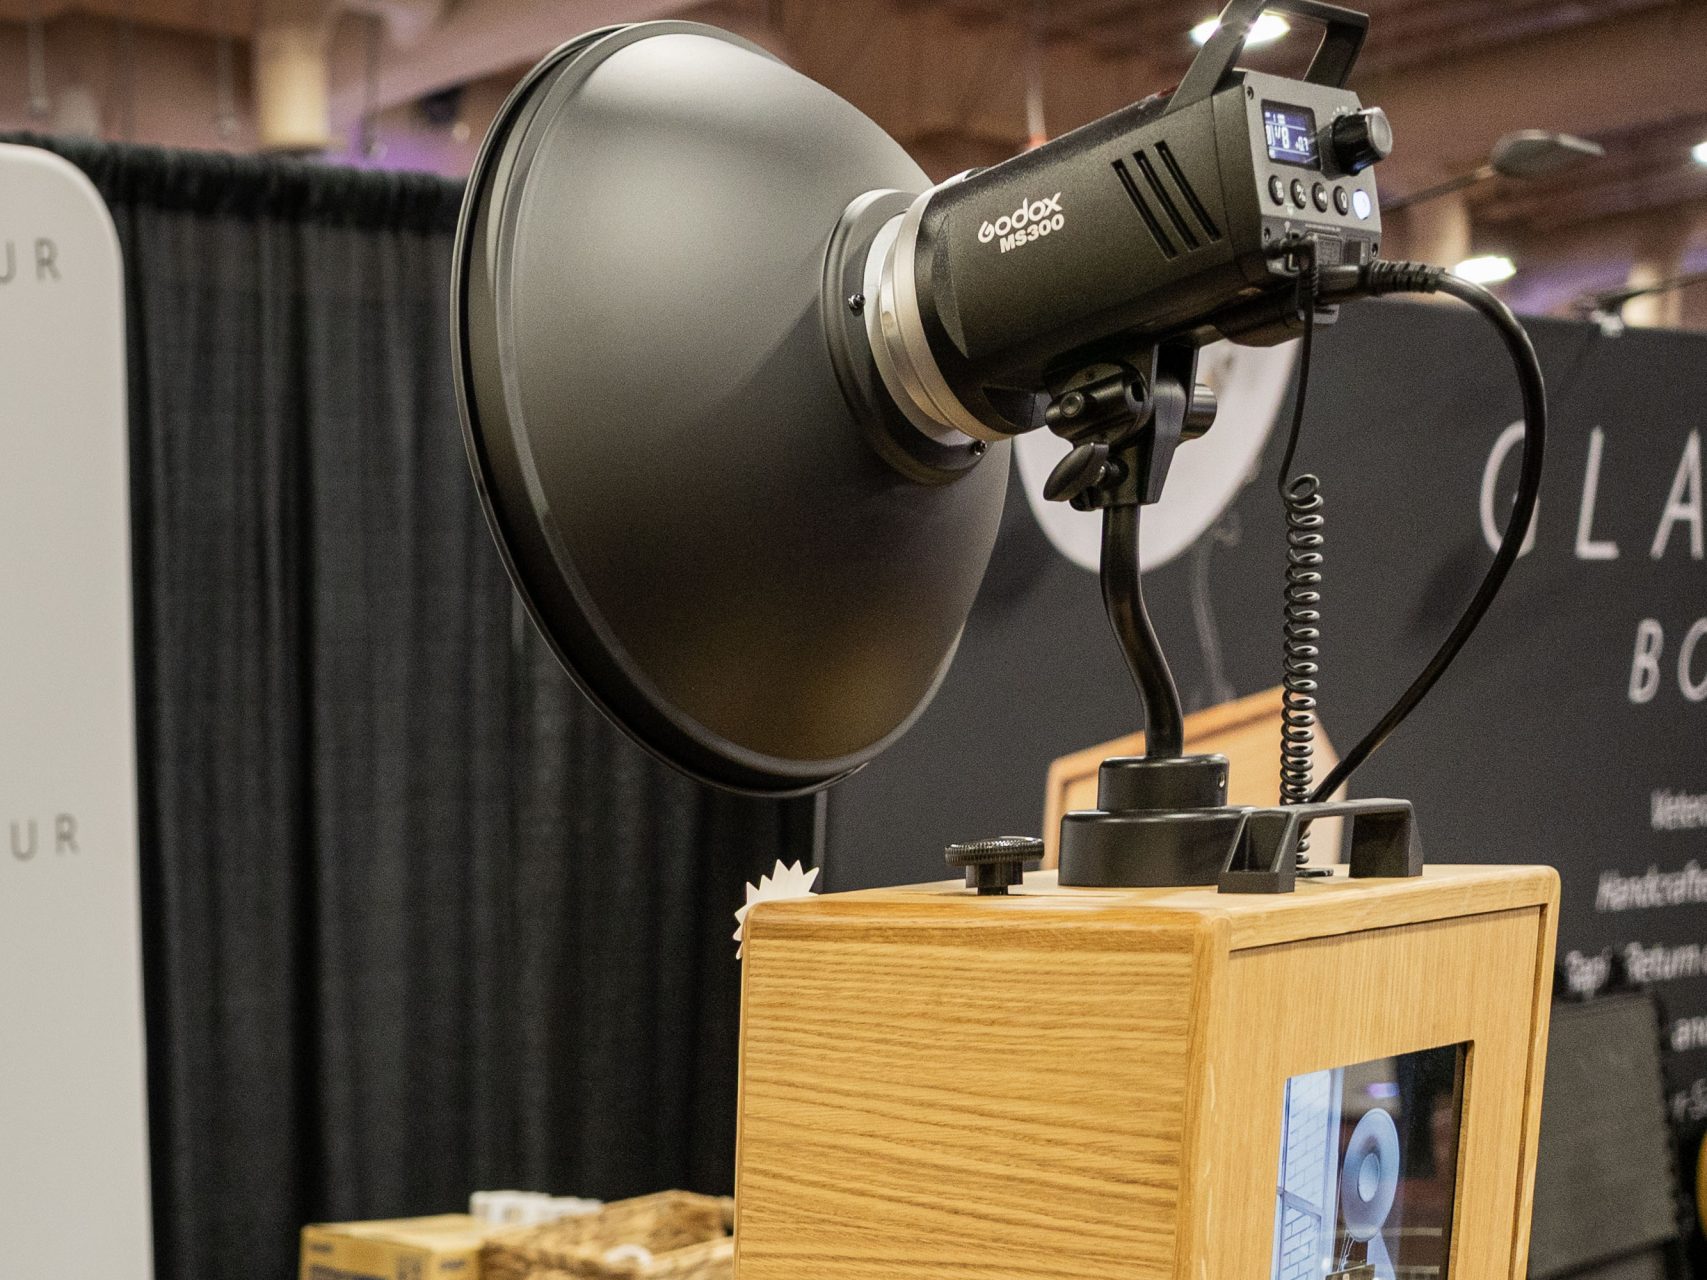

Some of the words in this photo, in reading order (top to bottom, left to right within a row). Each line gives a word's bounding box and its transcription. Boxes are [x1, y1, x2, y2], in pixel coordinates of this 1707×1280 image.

[978, 191, 1063, 243] Godox
[1000, 213, 1065, 254] MS300
[10, 812, 81, 862] UR
